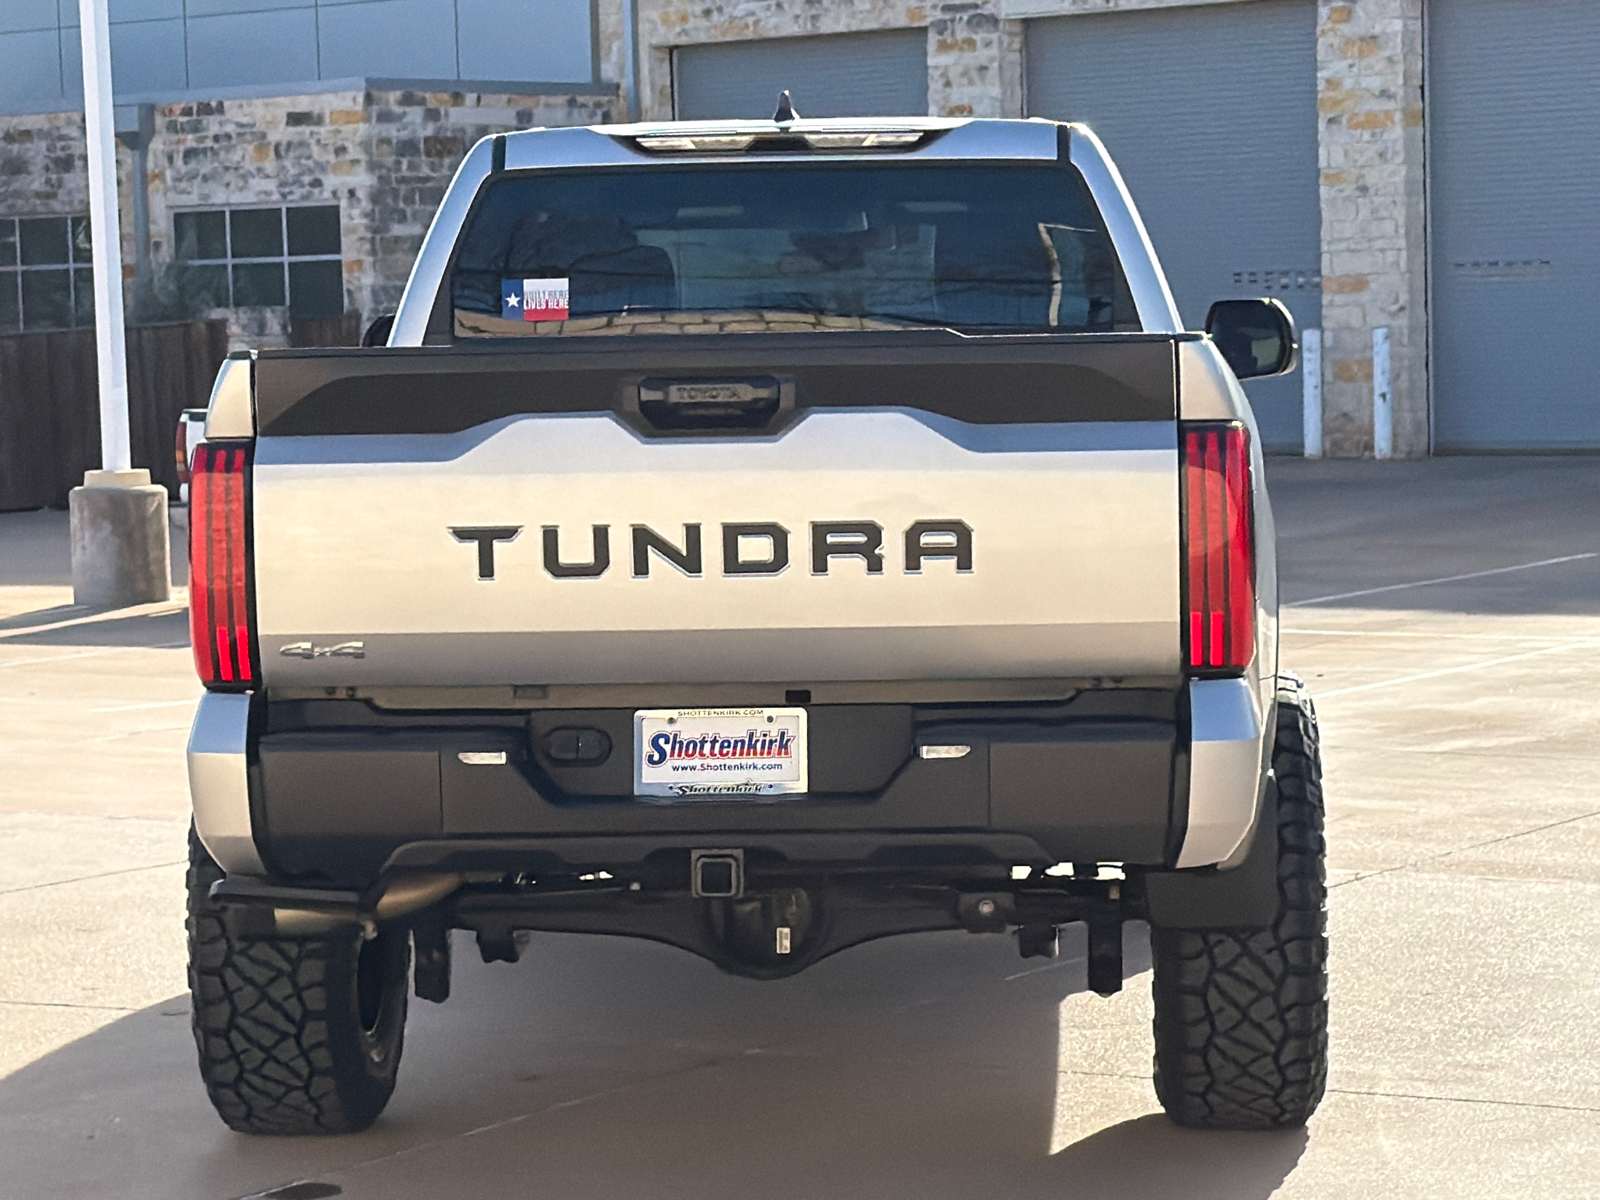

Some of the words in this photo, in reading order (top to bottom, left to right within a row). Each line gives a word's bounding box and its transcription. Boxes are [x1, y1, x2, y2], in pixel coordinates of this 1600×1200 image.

[547, 289, 569, 299] HERE
[524, 299, 546, 310] LIVES
[547, 298, 569, 309] HERE
[677, 387, 741, 400] TOYOTA
[448, 519, 974, 581] TUNDRA
[677, 709, 764, 717] SHOTTENKIRK.COM
[645, 729, 795, 768] Shottenkirk
[671, 762, 783, 772] www.Shottenkirk.com
[674, 783, 763, 795] Shottenkirk
